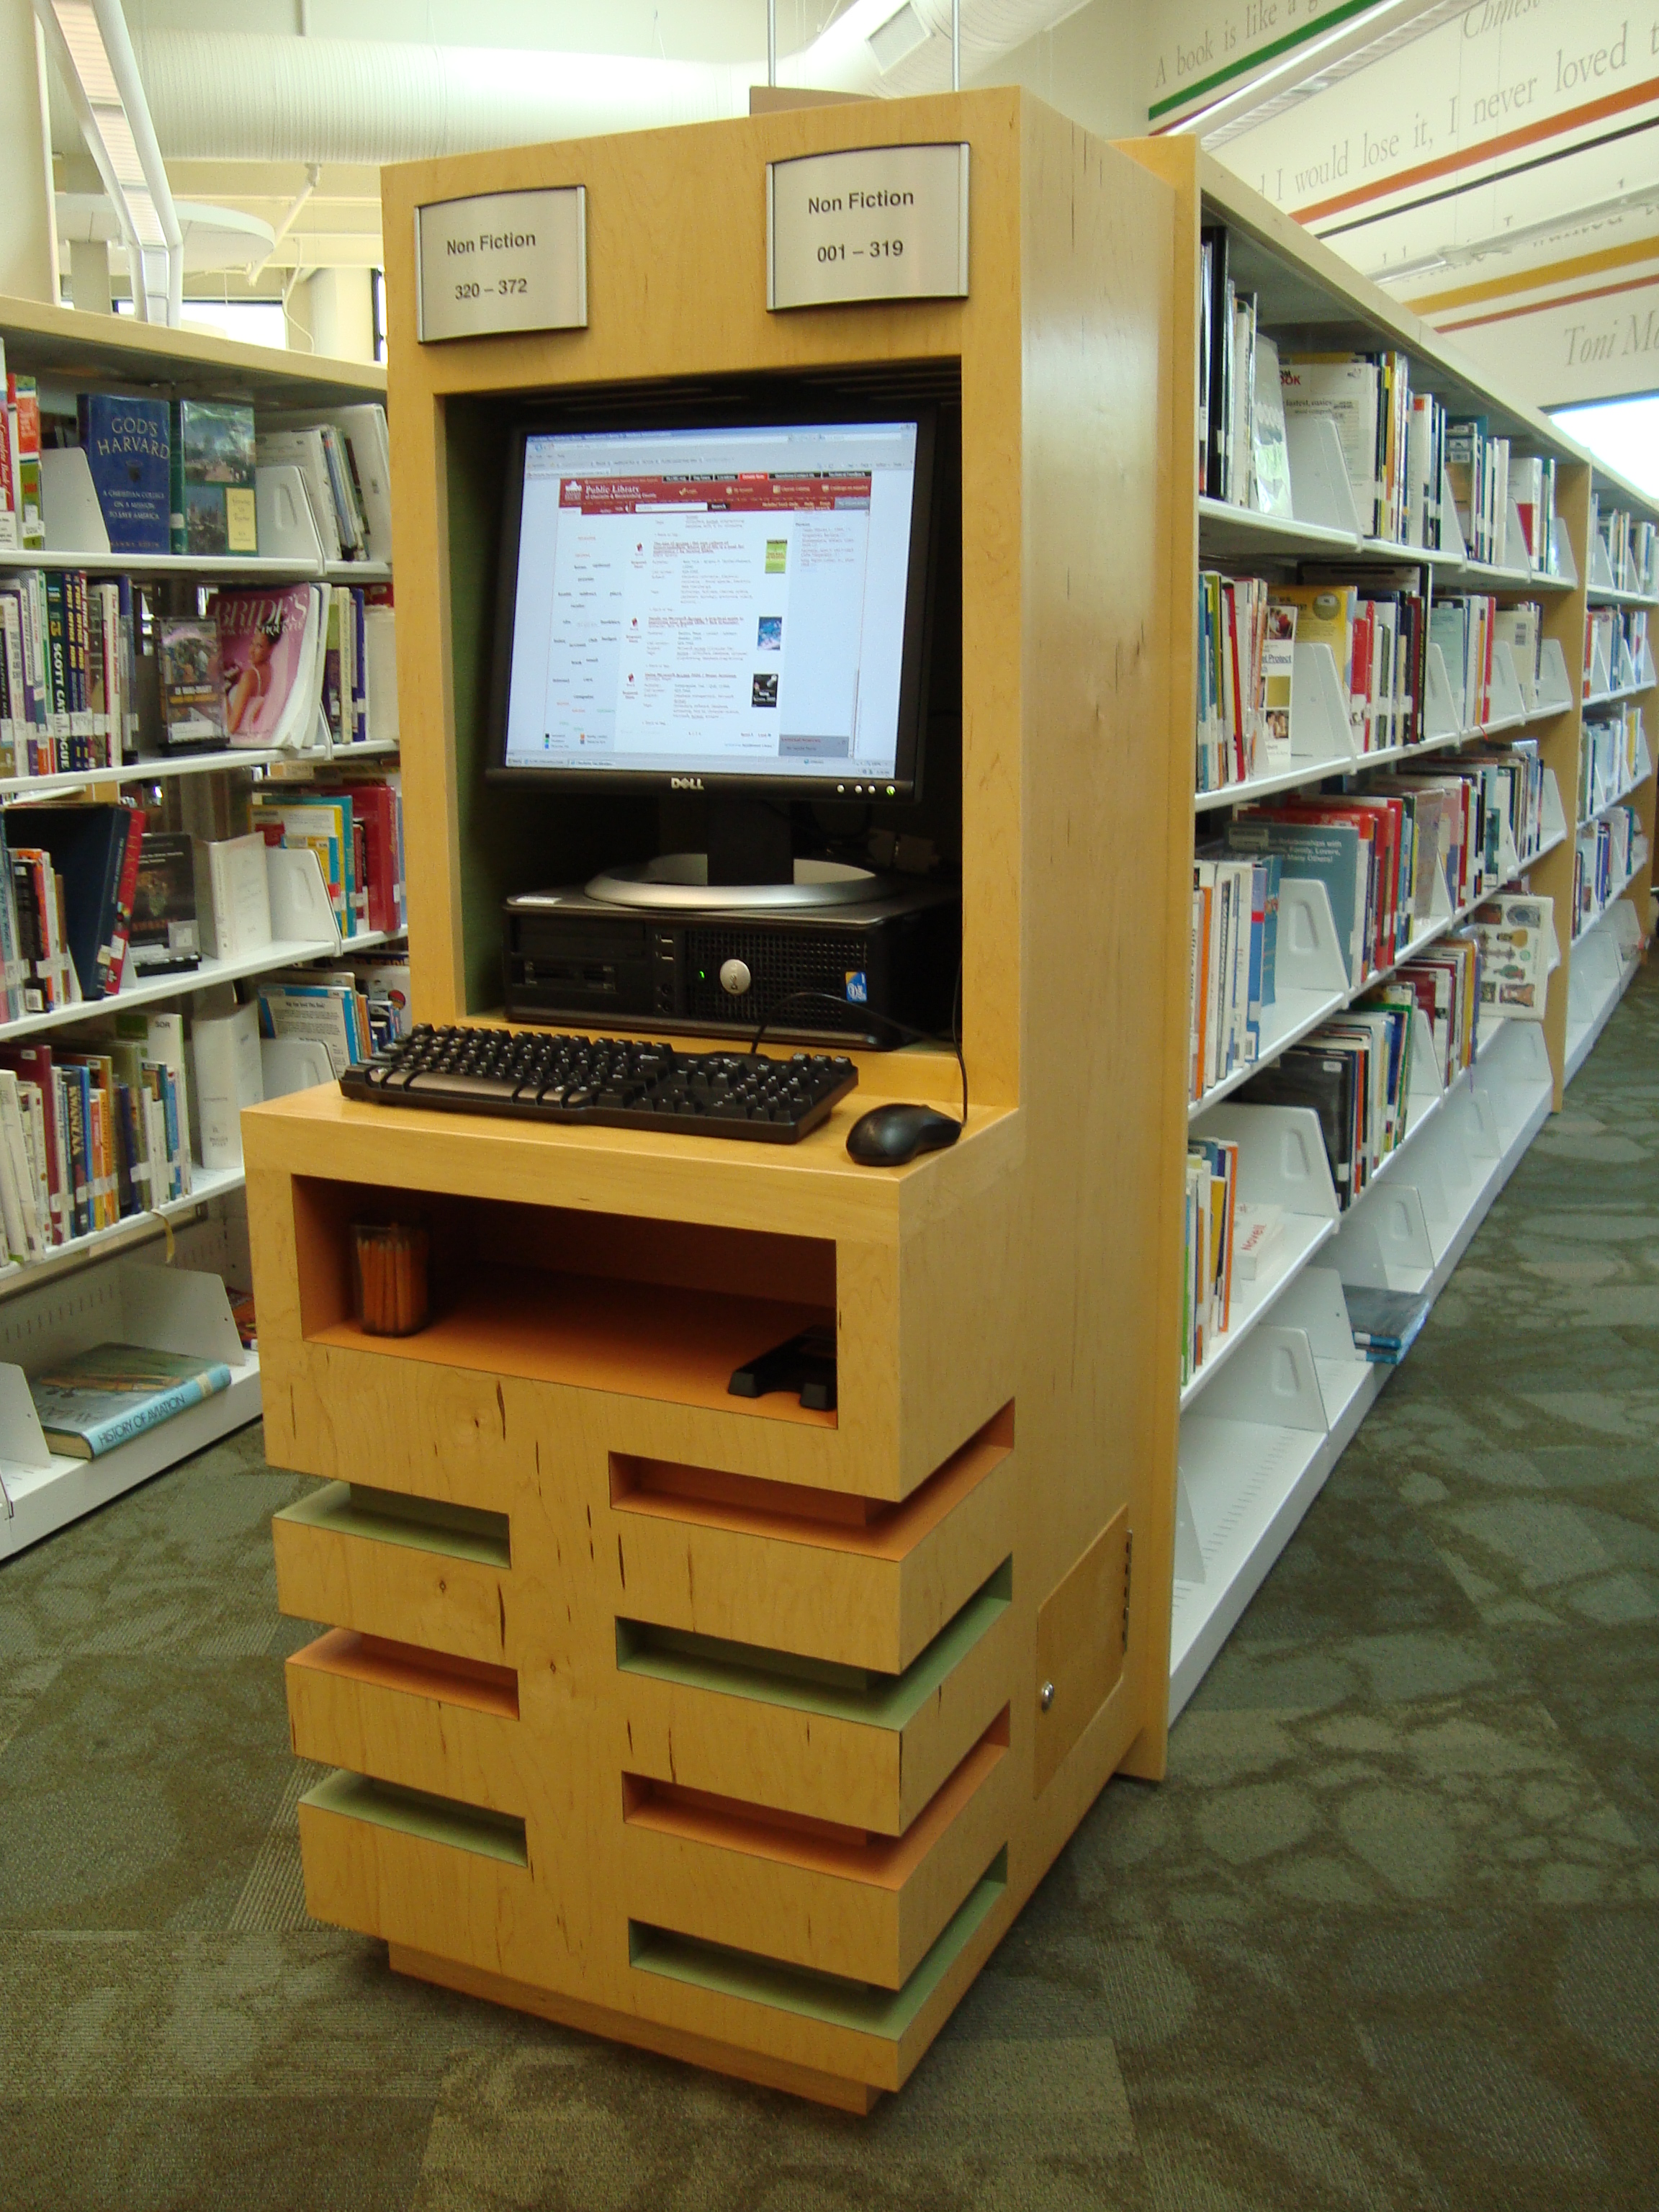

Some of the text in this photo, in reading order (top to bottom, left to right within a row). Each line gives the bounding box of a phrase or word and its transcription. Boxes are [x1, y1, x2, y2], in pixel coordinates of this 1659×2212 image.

[1155, 56, 1166, 89] A
[1177, 30, 1213, 76] book
[1224, 19, 1236, 51] is
[1246, 0, 1277, 39] like
[1275, 168, 1284, 202] I
[1295, 139, 1349, 194] would
[1362, 131, 1400, 168] lose
[1413, 112, 1433, 151] it,
[1448, 95, 1458, 135] I
[1473, 76, 1538, 125] never
[1553, 19, 1629, 93] loved
[808, 189, 914, 215] Non Fiction
[446, 232, 536, 256] Non Fiction
[817, 243, 845, 263] 001
[869, 239, 904, 258] 319
[455, 282, 480, 300] 320
[498, 277, 528, 295] 372
[1564, 318, 1619, 367] Toni
[111, 416, 158, 438] GOD'S
[97, 435, 170, 460] HARVARD
[585, 484, 639, 495] Public Library
[215, 592, 308, 627] BRIDE'S
[53, 642, 65, 687] SCOTT
[55, 691, 71, 770] CATOGUE
[670, 777, 705, 791] DELL
[68, 1086, 84, 1156] KWANZAA
[98, 1393, 186, 1447] HISTORY OF AVIATION
